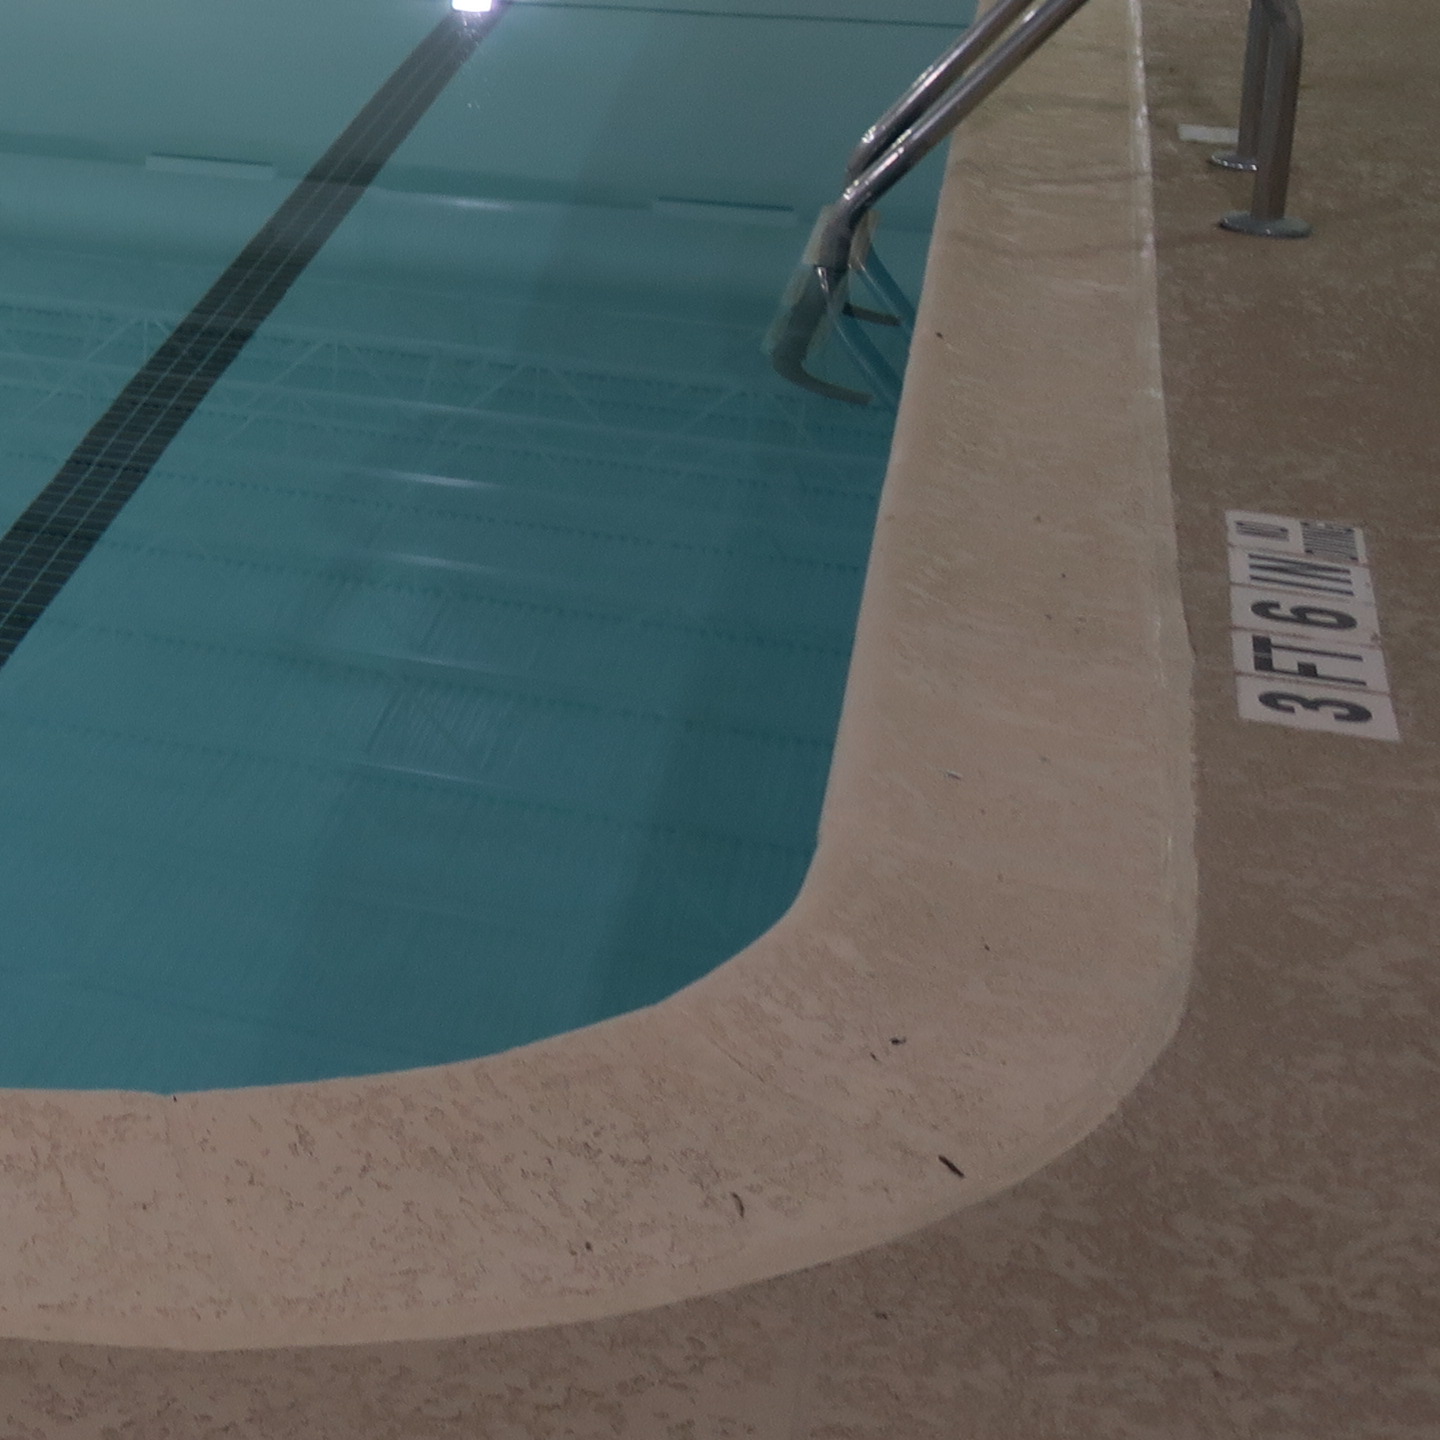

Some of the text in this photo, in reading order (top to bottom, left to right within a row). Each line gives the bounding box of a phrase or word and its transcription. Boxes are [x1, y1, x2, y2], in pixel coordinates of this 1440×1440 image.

[1248, 553, 1373, 723] 3 FT 6 IN
